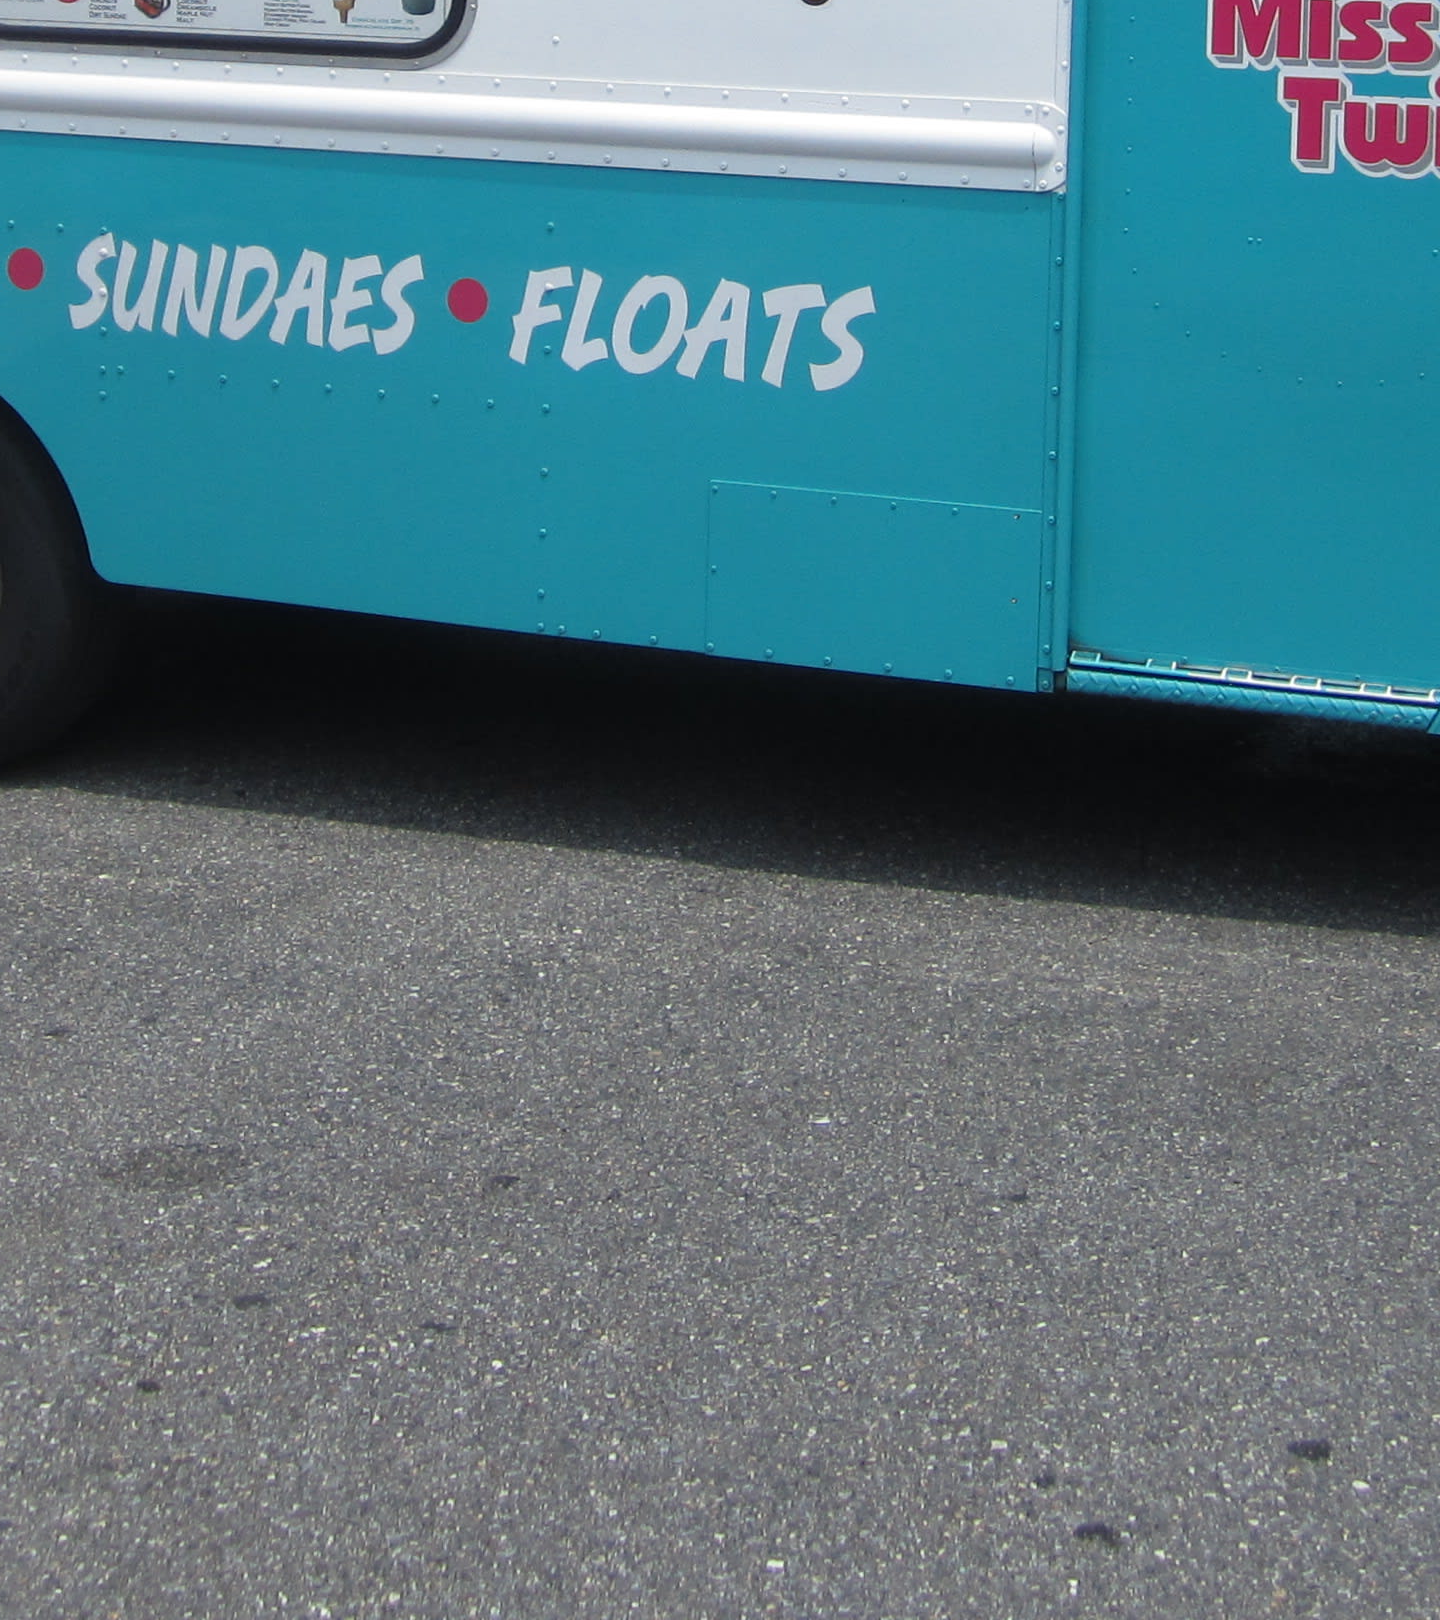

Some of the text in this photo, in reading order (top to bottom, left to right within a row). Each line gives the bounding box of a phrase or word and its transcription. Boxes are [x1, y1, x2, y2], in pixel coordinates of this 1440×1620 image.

[89, 3, 116, 11] COCONUT
[69, 233, 424, 356] SUNDAES
[509, 266, 876, 392] FLOATS
